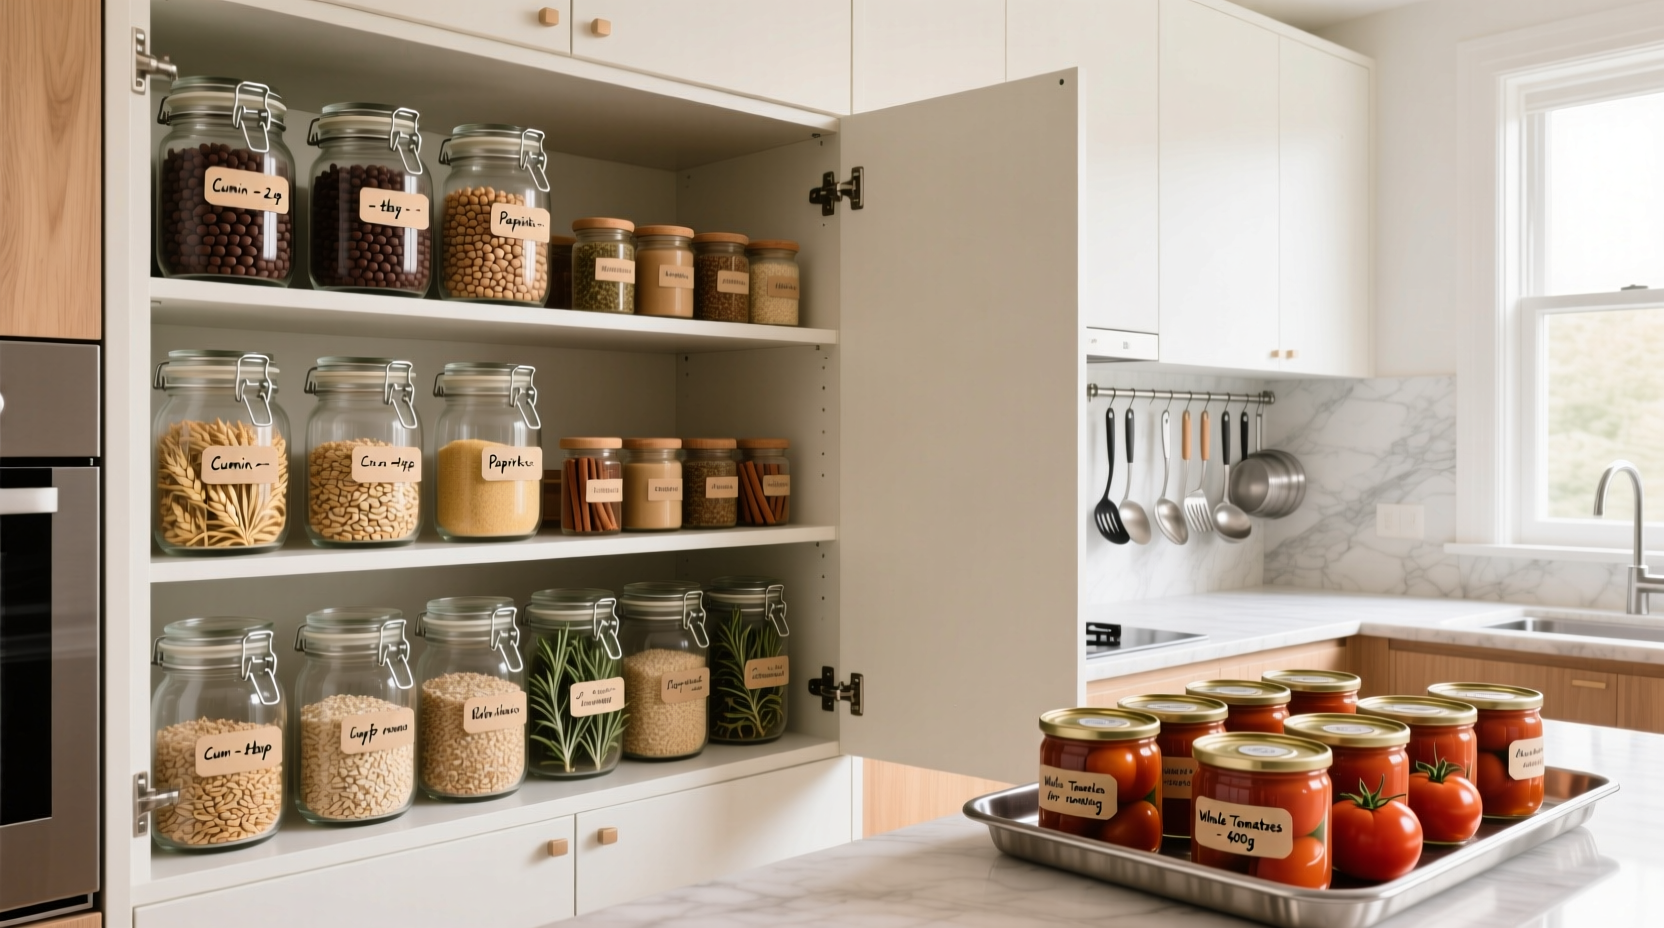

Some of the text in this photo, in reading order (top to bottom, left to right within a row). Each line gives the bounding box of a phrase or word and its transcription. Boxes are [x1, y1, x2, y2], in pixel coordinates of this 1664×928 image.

[212, 177, 248, 196] Cumin
[211, 455, 253, 471] Cumin
[1227, 830, 1255, 852] 400g
